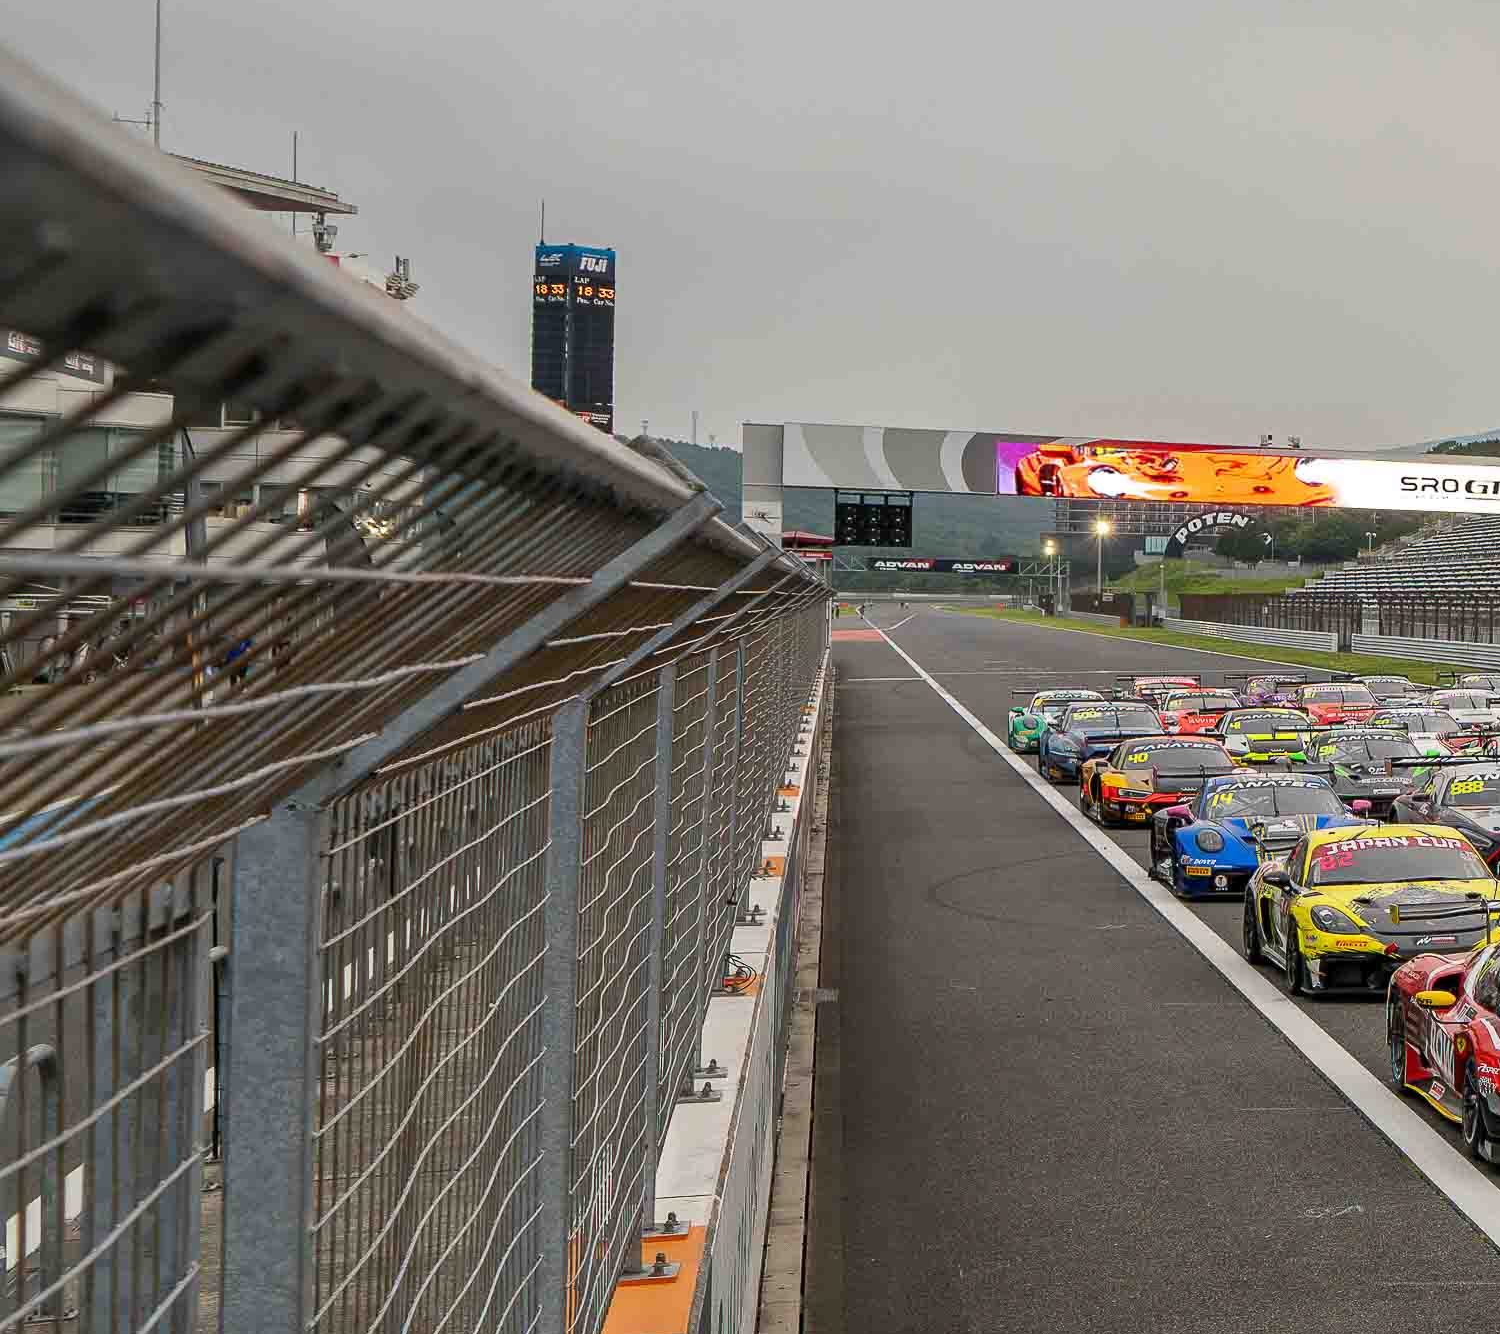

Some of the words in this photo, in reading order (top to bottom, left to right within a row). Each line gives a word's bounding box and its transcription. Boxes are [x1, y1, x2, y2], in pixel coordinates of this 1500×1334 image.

[580, 257, 608, 273] FUJI
[535, 284, 548, 295] 18
[578, 286, 593, 297] 18
[598, 288, 615, 299] 33
[1400, 475, 1460, 494] SRO
[874, 560, 930, 570] ADVAN
[951, 562, 1009, 571] ADVAN
[1216, 779, 1321, 791] FANATEC
[1450, 781, 1485, 796] 888
[1211, 792, 1233, 807] 14
[1326, 836, 1410, 855] JAPAN
[1414, 836, 1462, 849] CUP
